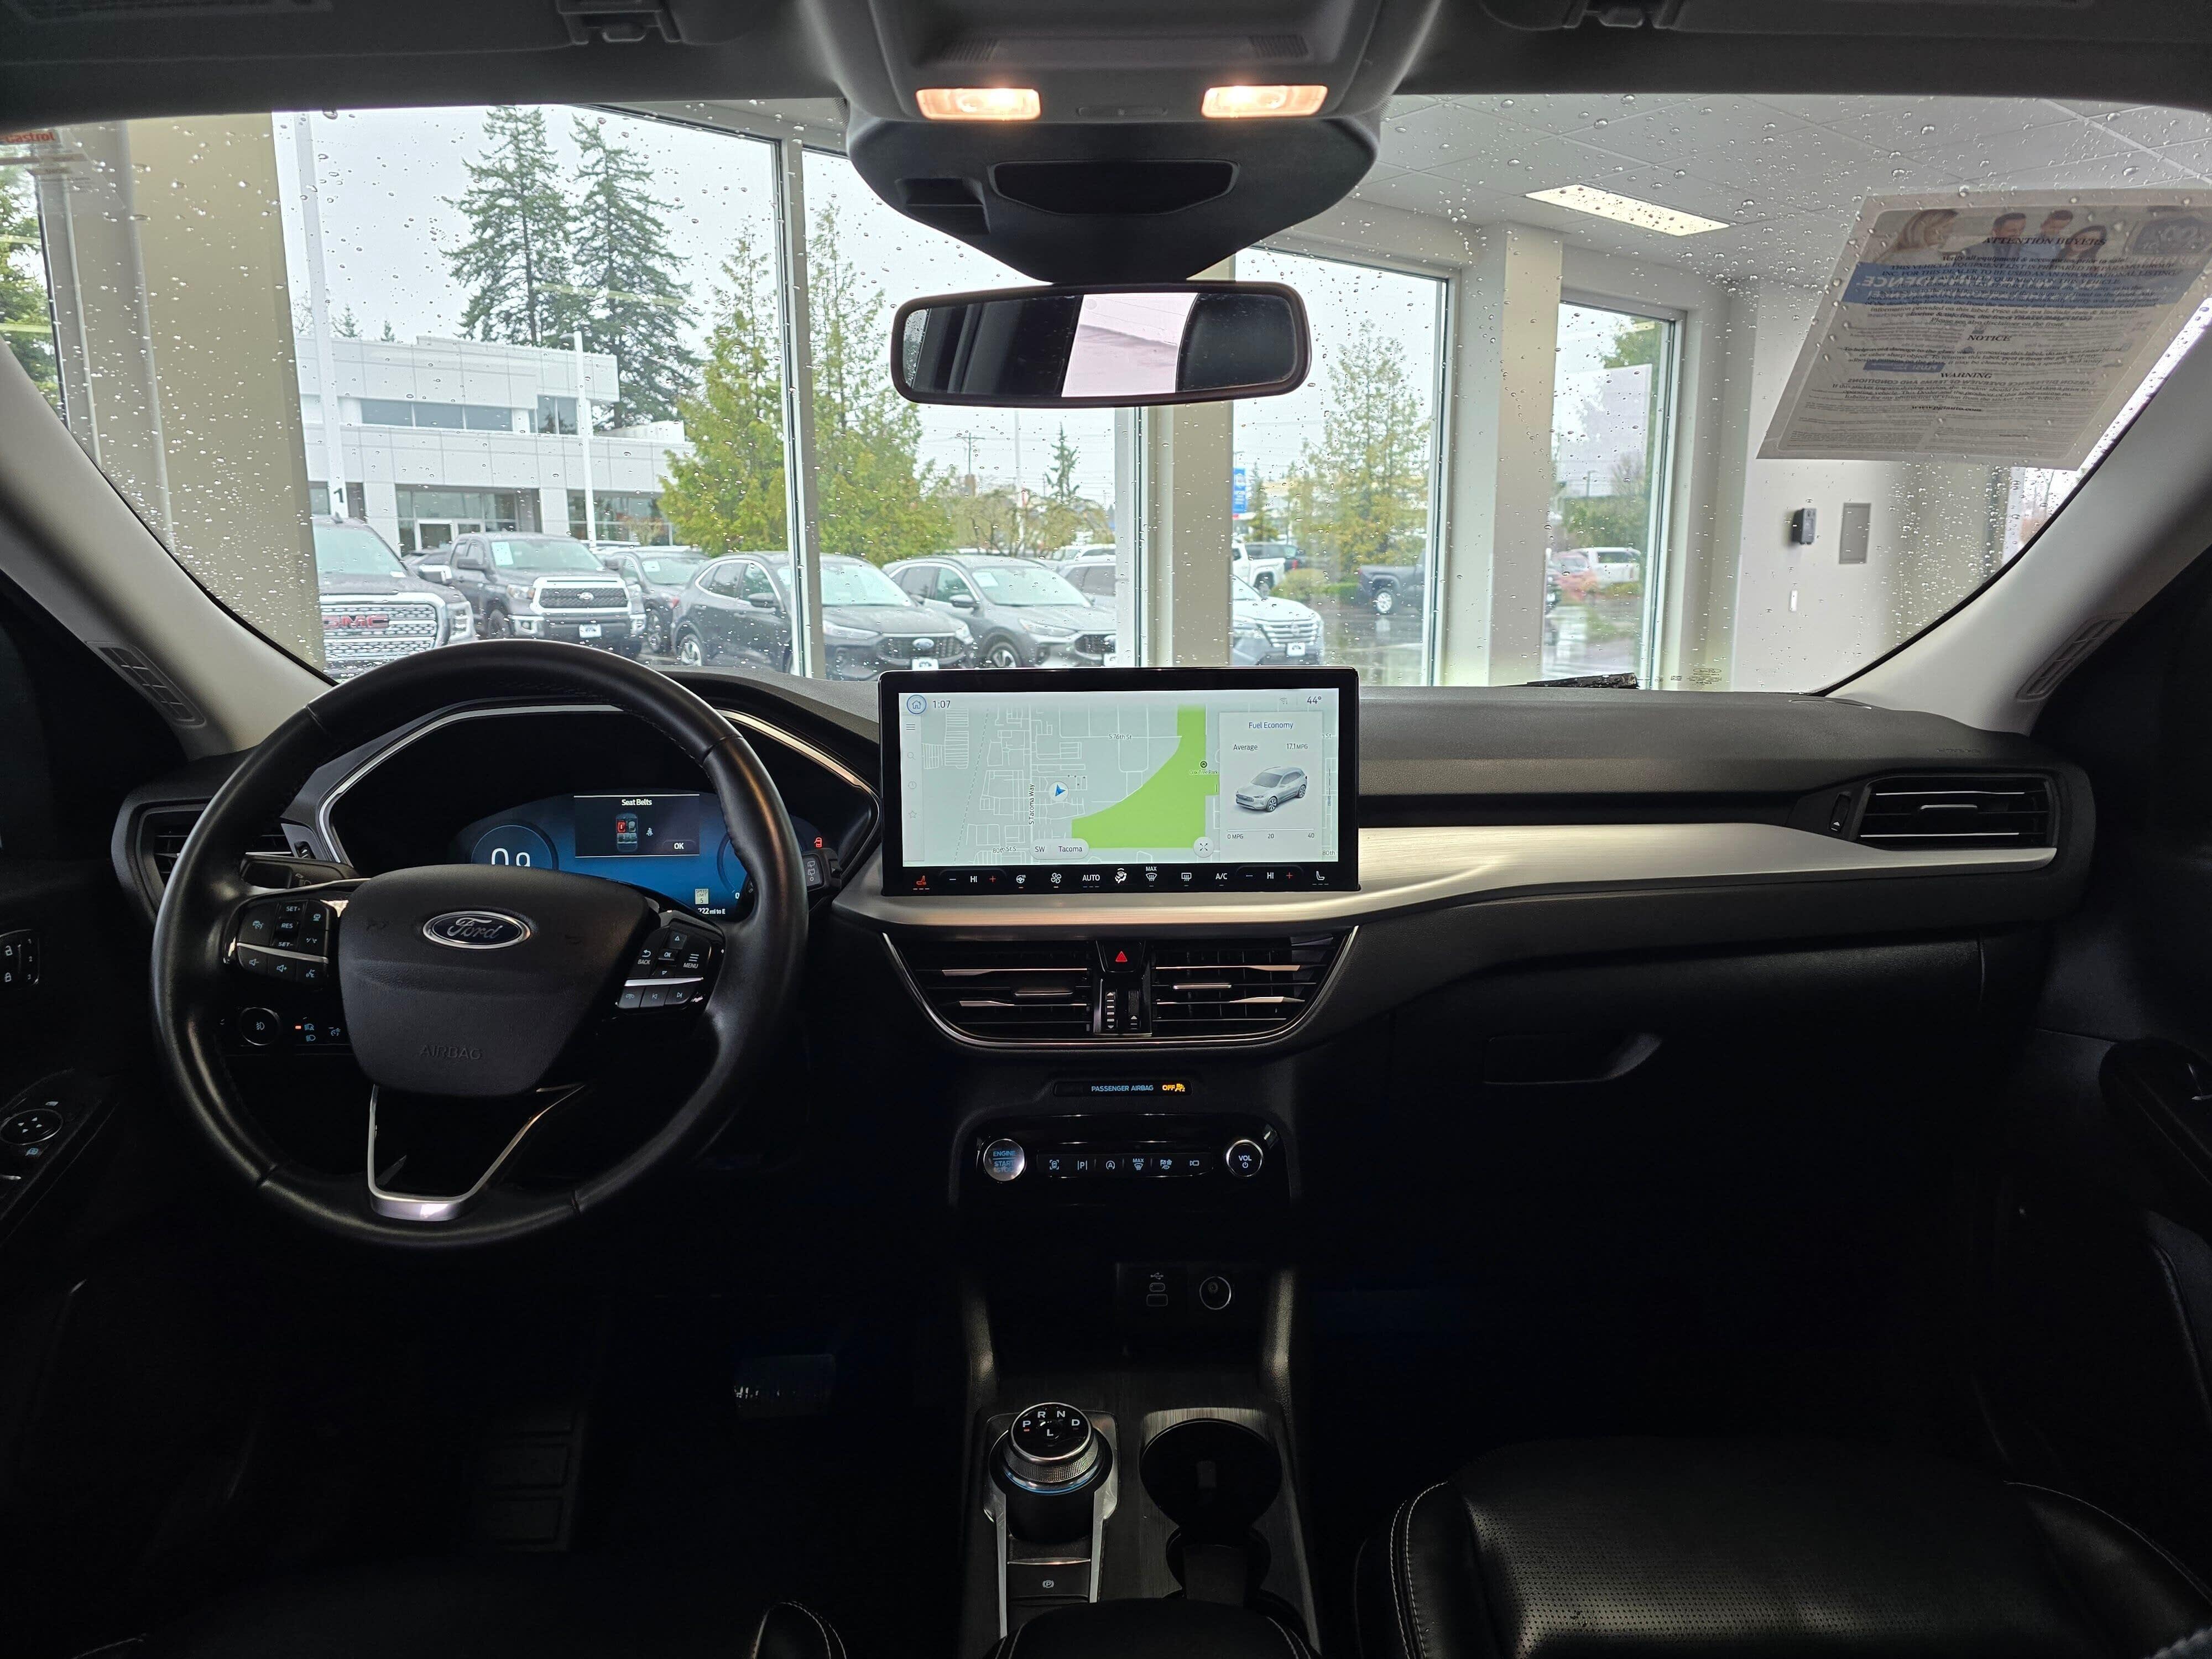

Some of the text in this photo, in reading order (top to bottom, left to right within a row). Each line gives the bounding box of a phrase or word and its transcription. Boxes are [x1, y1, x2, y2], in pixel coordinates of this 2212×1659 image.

[333, 488, 344, 503] 1
[322, 614, 389, 629] GMC
[932, 700, 951, 708] 1:07
[447, 917, 503, 939] Ford
[419, 1045, 482, 1060] AIRBAG
